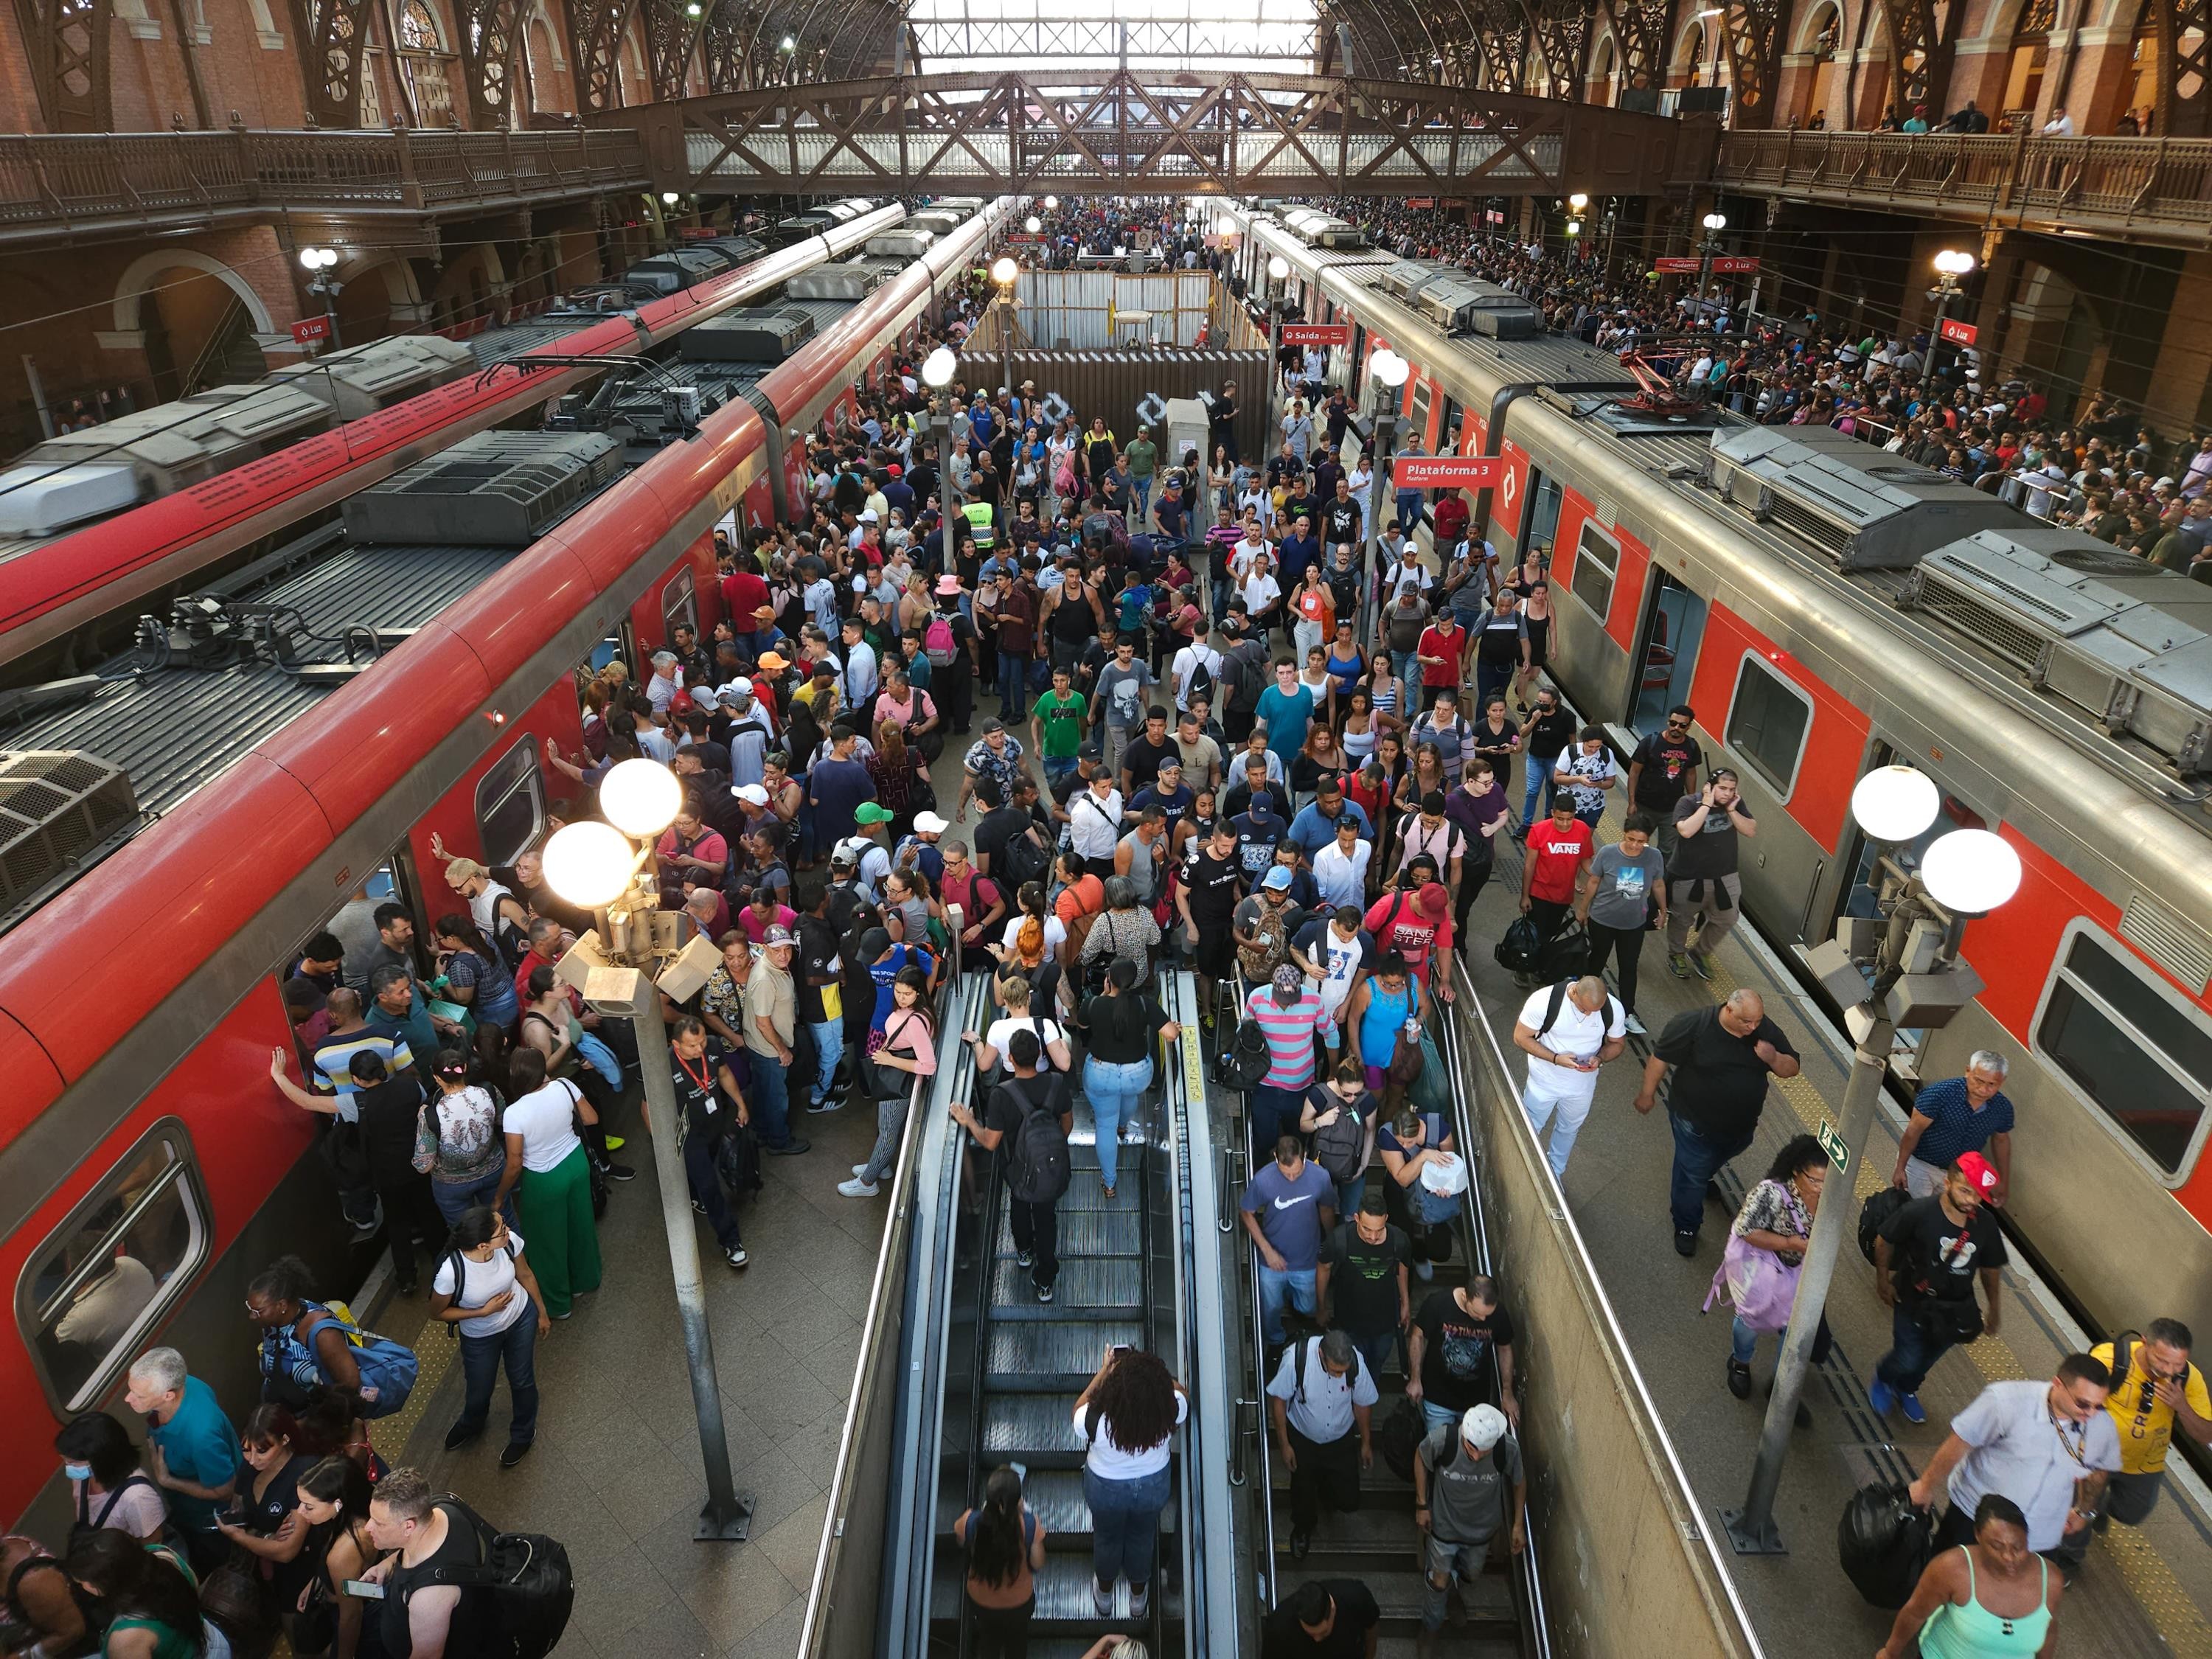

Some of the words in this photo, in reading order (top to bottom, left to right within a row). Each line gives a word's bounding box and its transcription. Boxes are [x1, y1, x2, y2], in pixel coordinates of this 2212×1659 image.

[310, 324, 323, 334] Luz
[1956, 329, 1969, 340] Luz
[1295, 331, 1320, 339] Saída
[1407, 465, 1477, 476] Plataforma
[1481, 465, 1489, 476] 3
[1547, 842, 1581, 855] VANS
[1394, 925, 1434, 938] GANG
